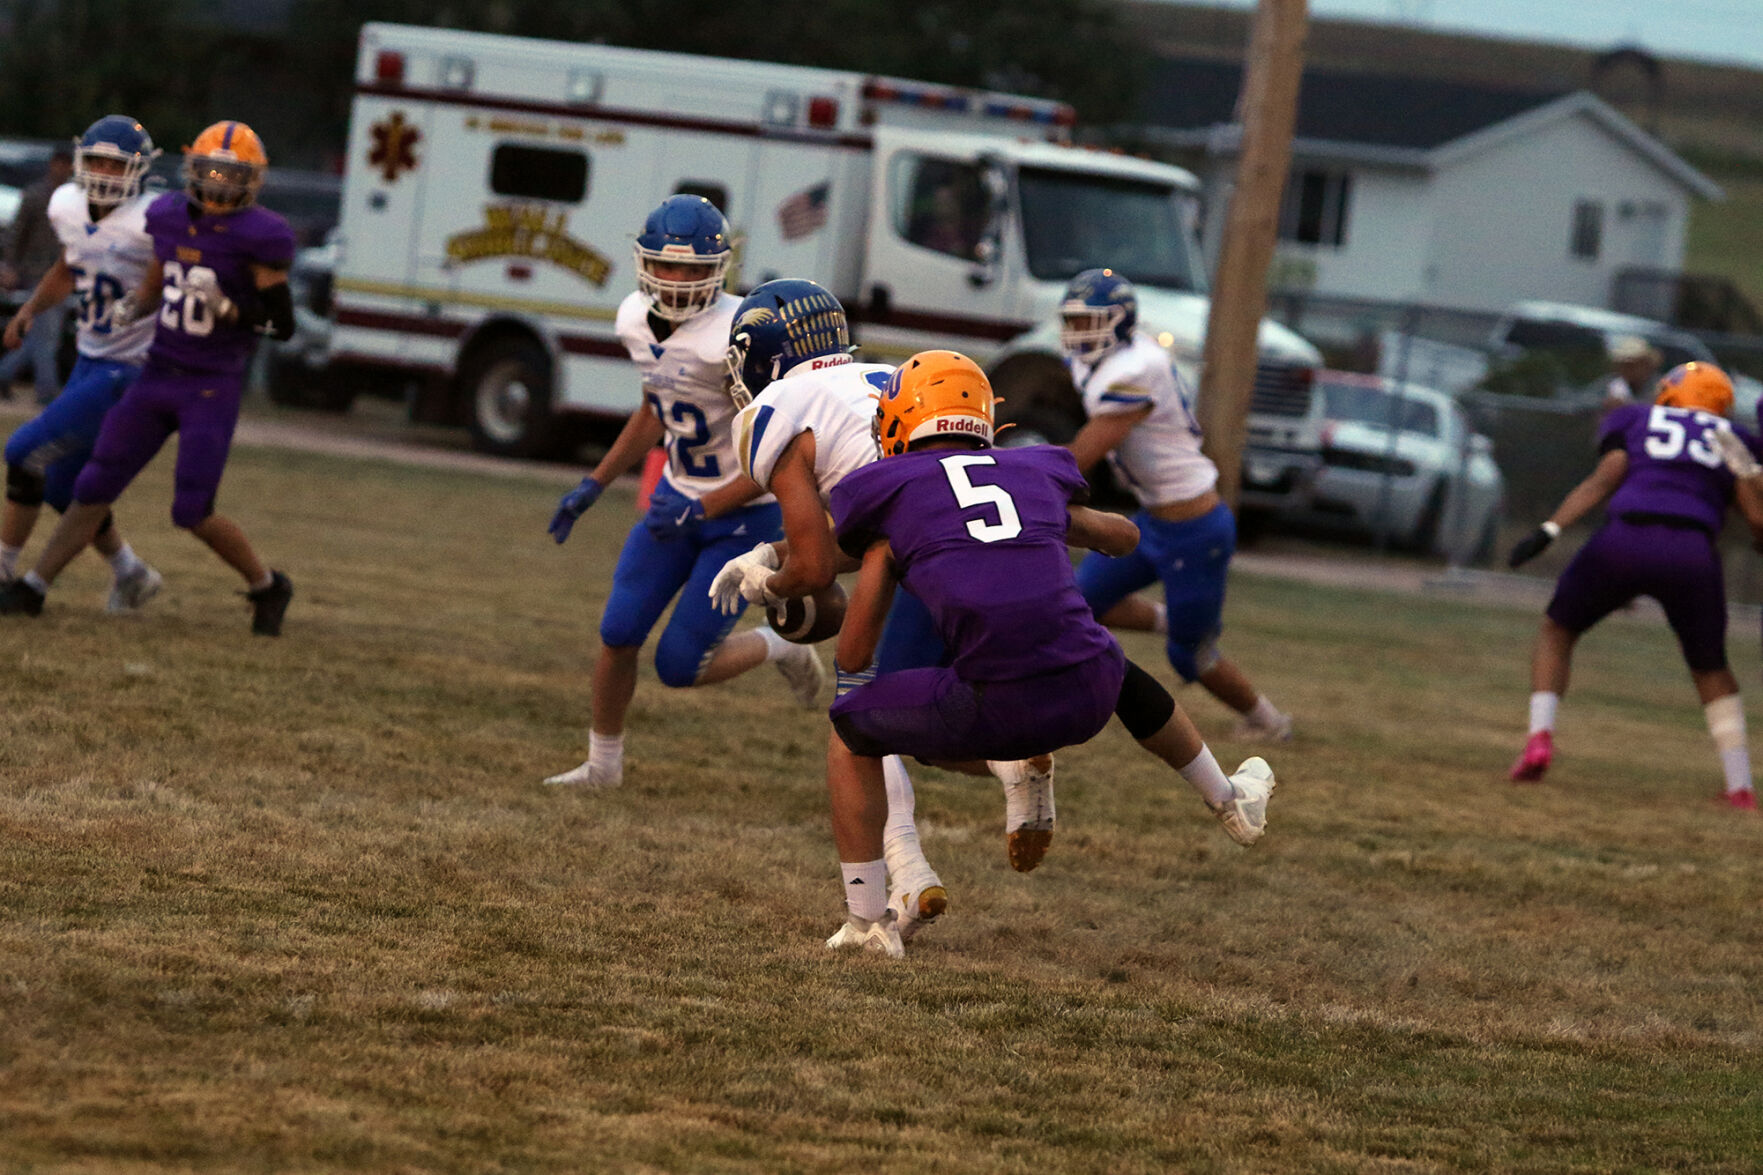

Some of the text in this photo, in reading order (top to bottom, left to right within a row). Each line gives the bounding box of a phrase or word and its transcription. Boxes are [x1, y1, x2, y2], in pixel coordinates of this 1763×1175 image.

[936, 418, 988, 438] Riddell
[1644, 405, 1731, 469] 53
[939, 454, 1023, 543] 5
